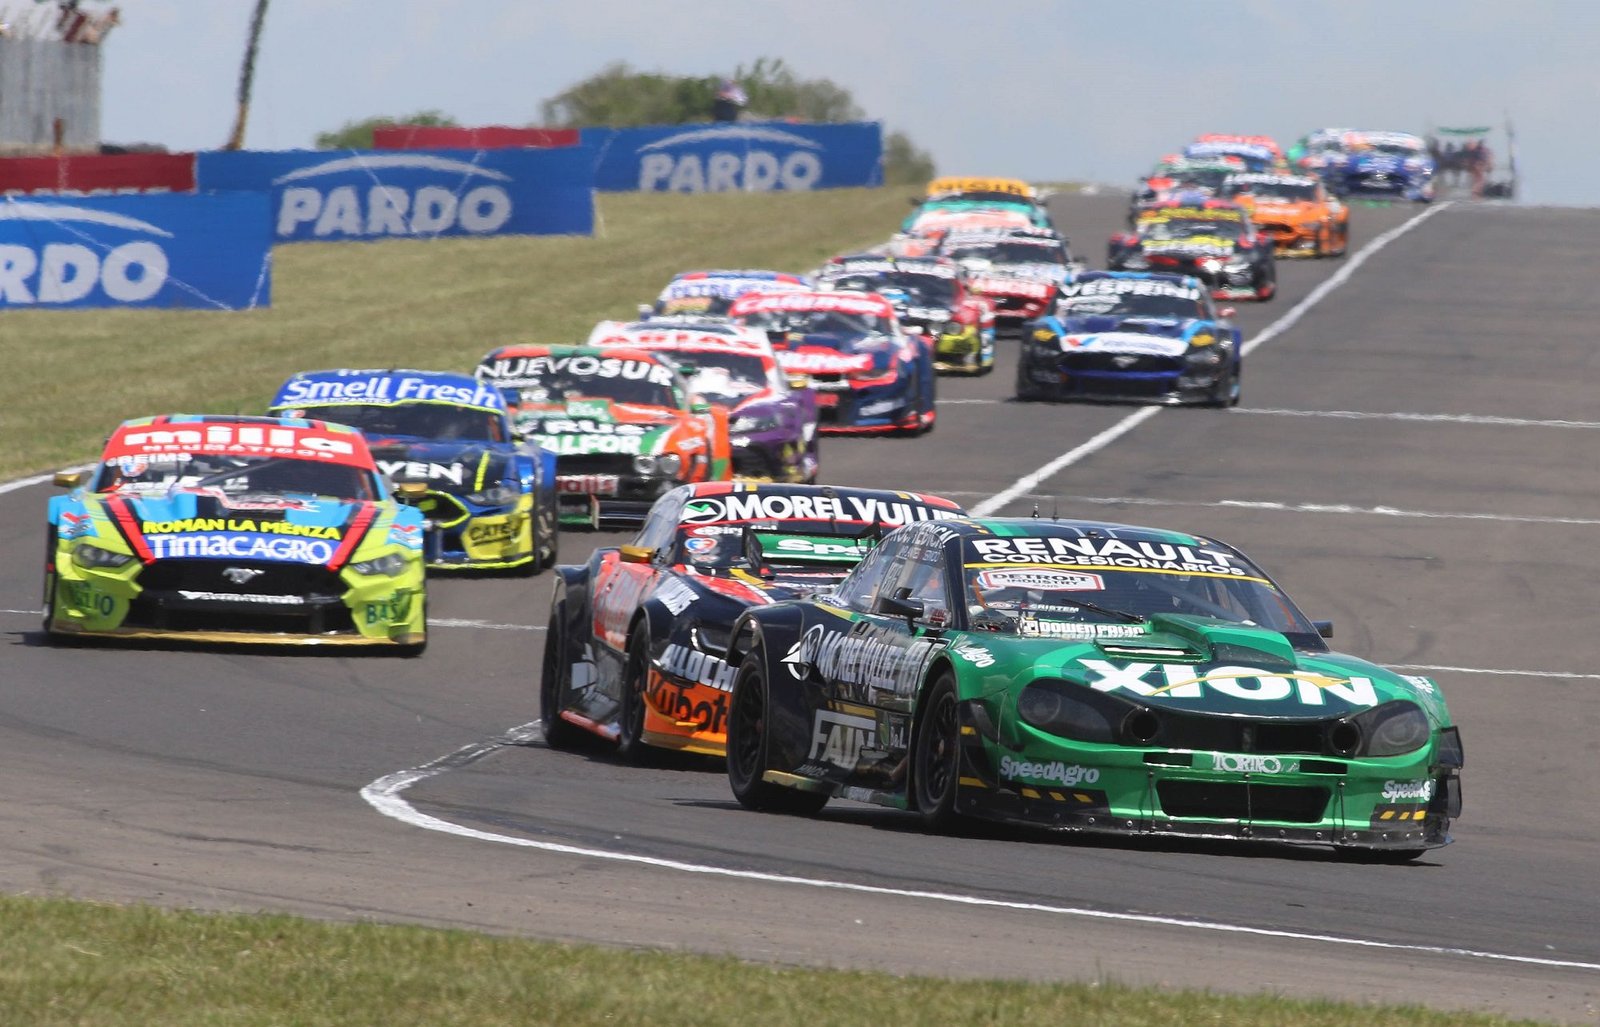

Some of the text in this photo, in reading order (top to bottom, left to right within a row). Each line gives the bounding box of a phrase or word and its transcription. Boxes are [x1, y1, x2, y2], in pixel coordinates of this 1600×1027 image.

[639, 151, 823, 192] PARDO
[276, 186, 512, 236] PARDO
[1061, 279, 1200, 300] VESPRINI
[474, 356, 674, 386] NUEVOSUR
[283, 376, 497, 408] Smell Fresh
[125, 426, 353, 455] milla
[727, 494, 854, 521] MOREL
[143, 518, 341, 540] ROMAN LA MENZA
[971, 537, 1235, 568] RENAULT
[982, 552, 1246, 577] CONCESIONARIOS
[992, 573, 1090, 583] DETROIT
[1006, 578, 1080, 586] INDUSTRY
[1039, 621, 1095, 635] DOWEN
[1075, 657, 1379, 706] XION
[651, 669, 728, 734] Kubot
[1000, 755, 1100, 787] SpeedAgro
[1213, 751, 1281, 774] TORINO
